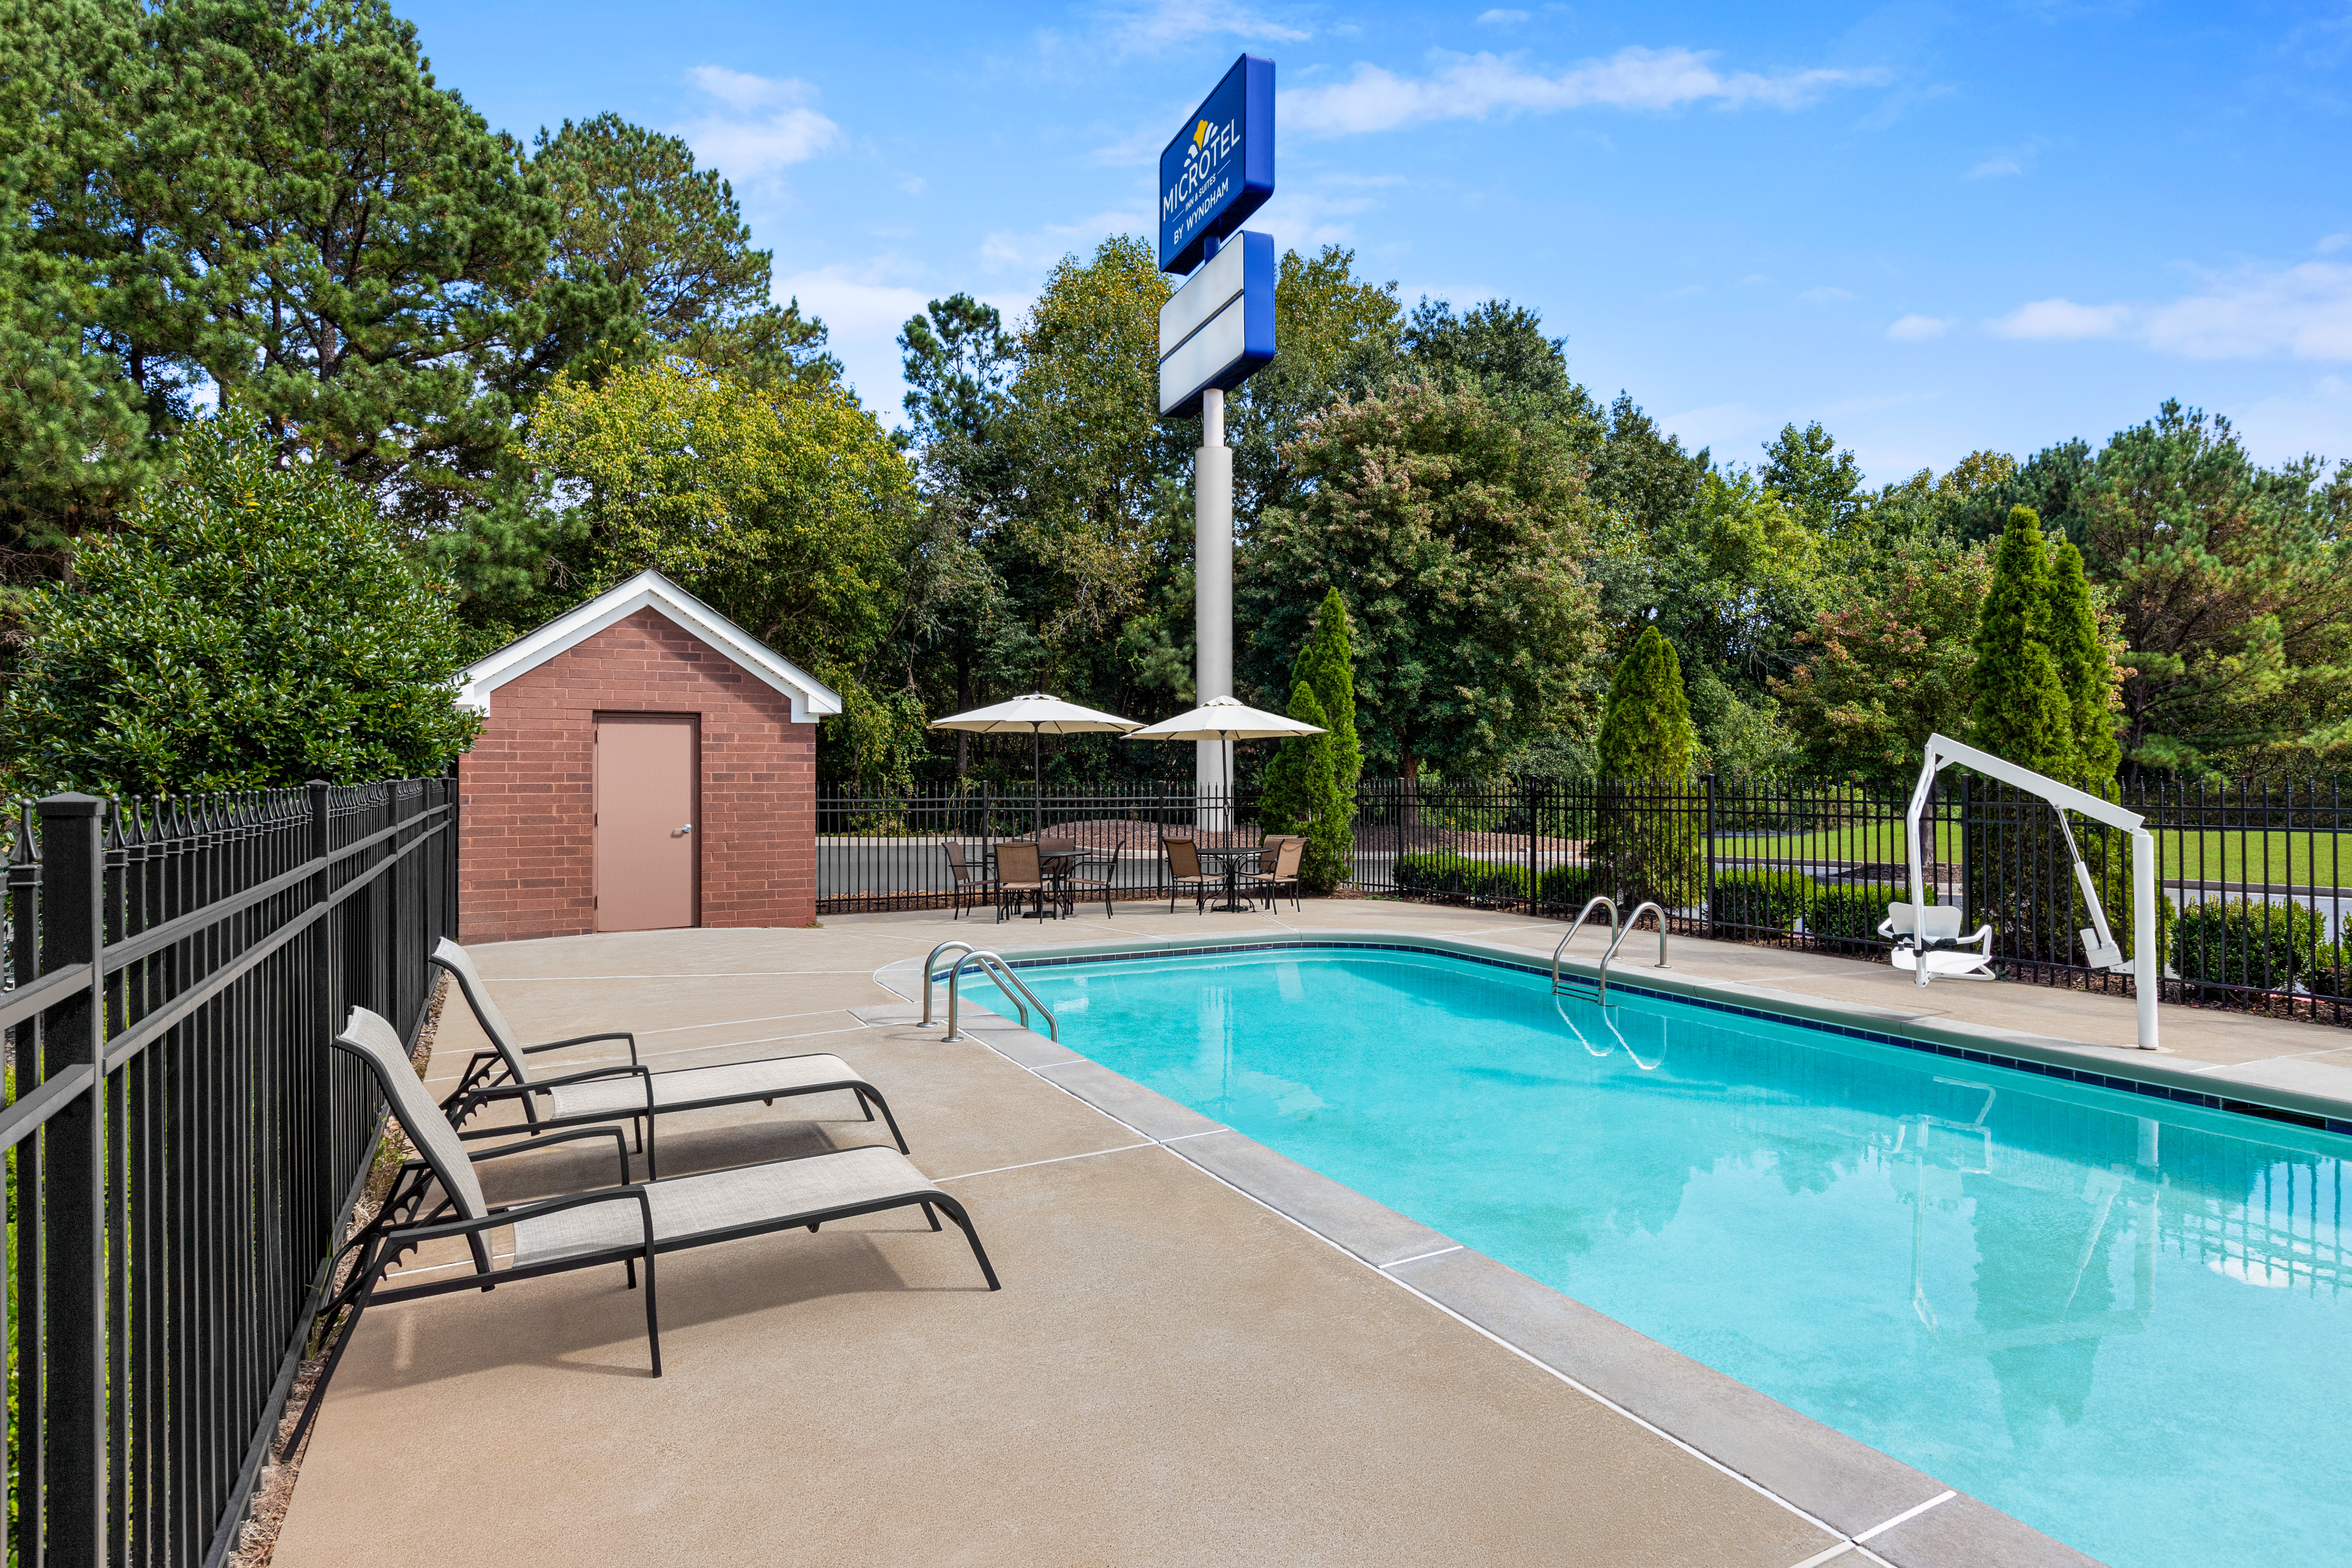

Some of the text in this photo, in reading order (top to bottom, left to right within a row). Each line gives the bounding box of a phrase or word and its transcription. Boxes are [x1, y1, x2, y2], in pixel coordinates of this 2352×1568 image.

[1163, 118, 1240, 222] MICROTEL
[1185, 173, 1216, 212] INN & SUITES
[1174, 177, 1229, 245] BY WYNDHAM
